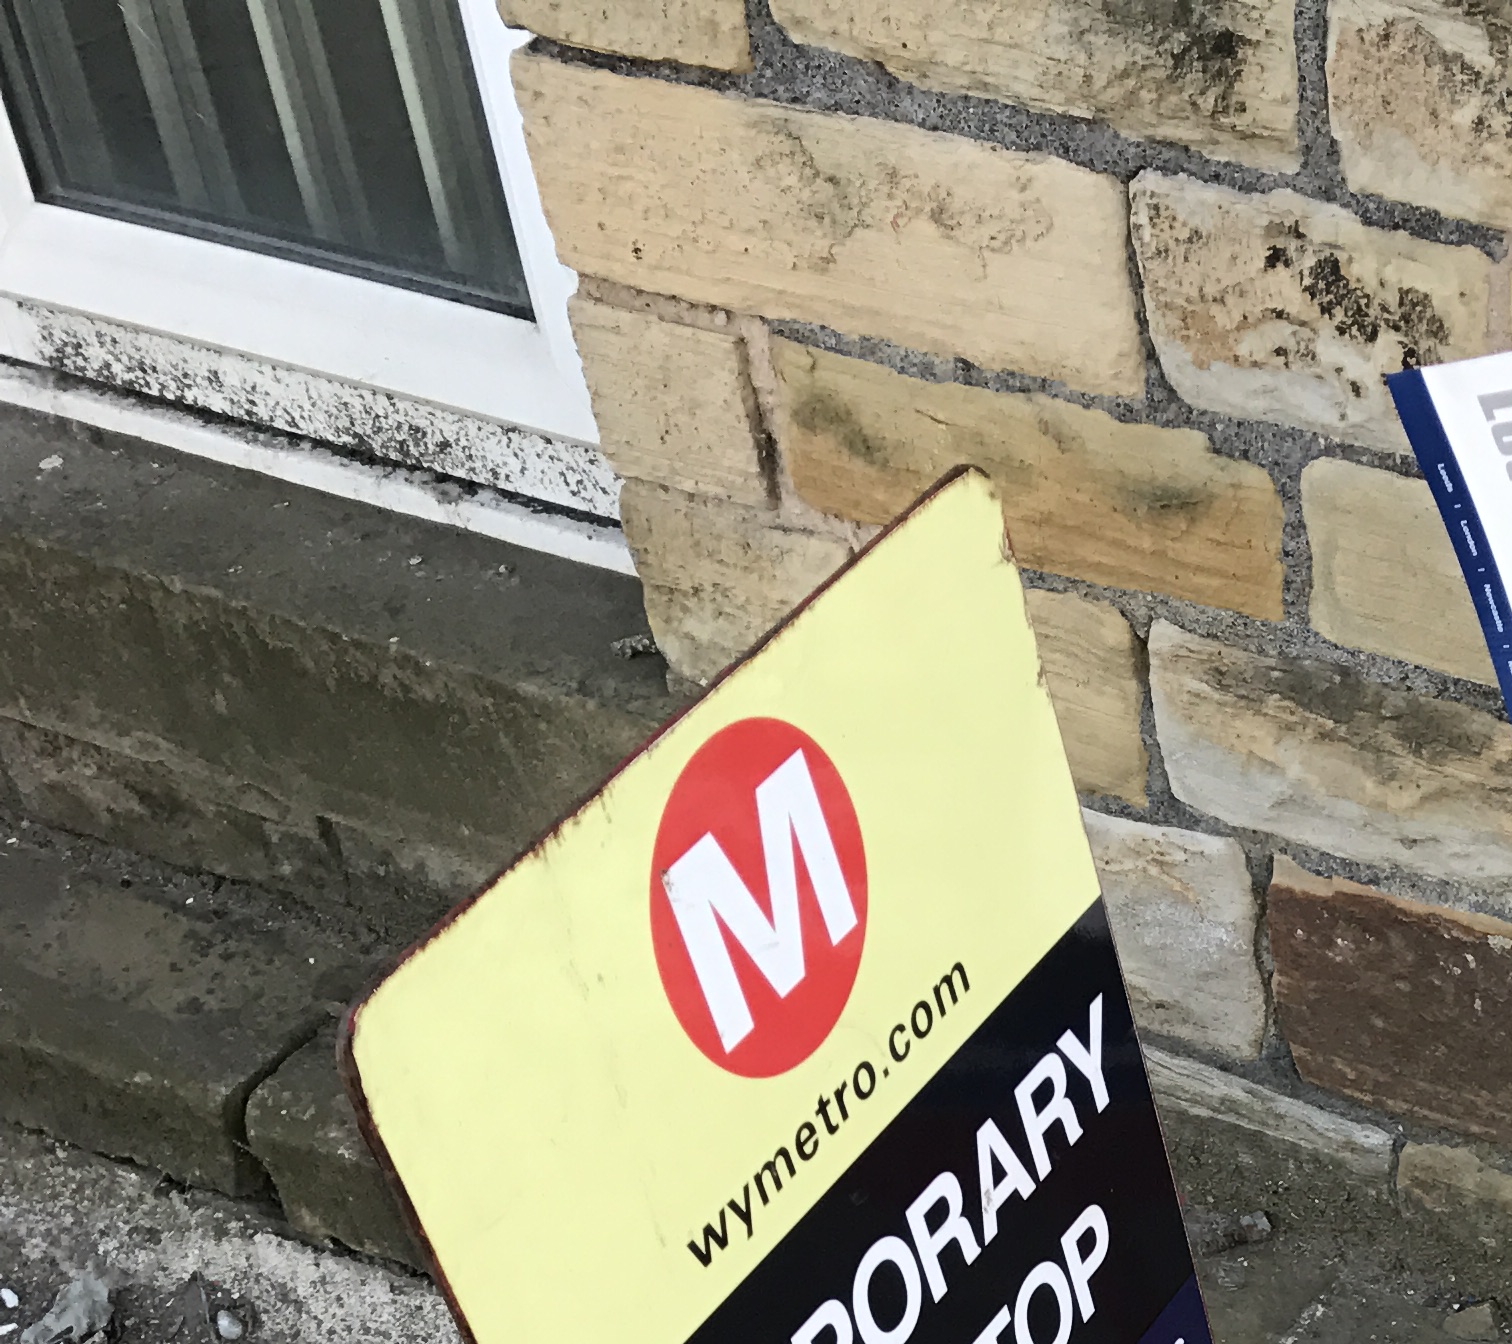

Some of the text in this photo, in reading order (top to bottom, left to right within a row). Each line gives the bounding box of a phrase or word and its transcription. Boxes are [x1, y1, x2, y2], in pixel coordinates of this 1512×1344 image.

[1437, 462, 1454, 493] Leeds
[1460, 519, 1478, 557] London
[1483, 583, 1504, 633] Newcastle
[661, 747, 859, 1055] M
[686, 961, 972, 1268] wymetro.com
